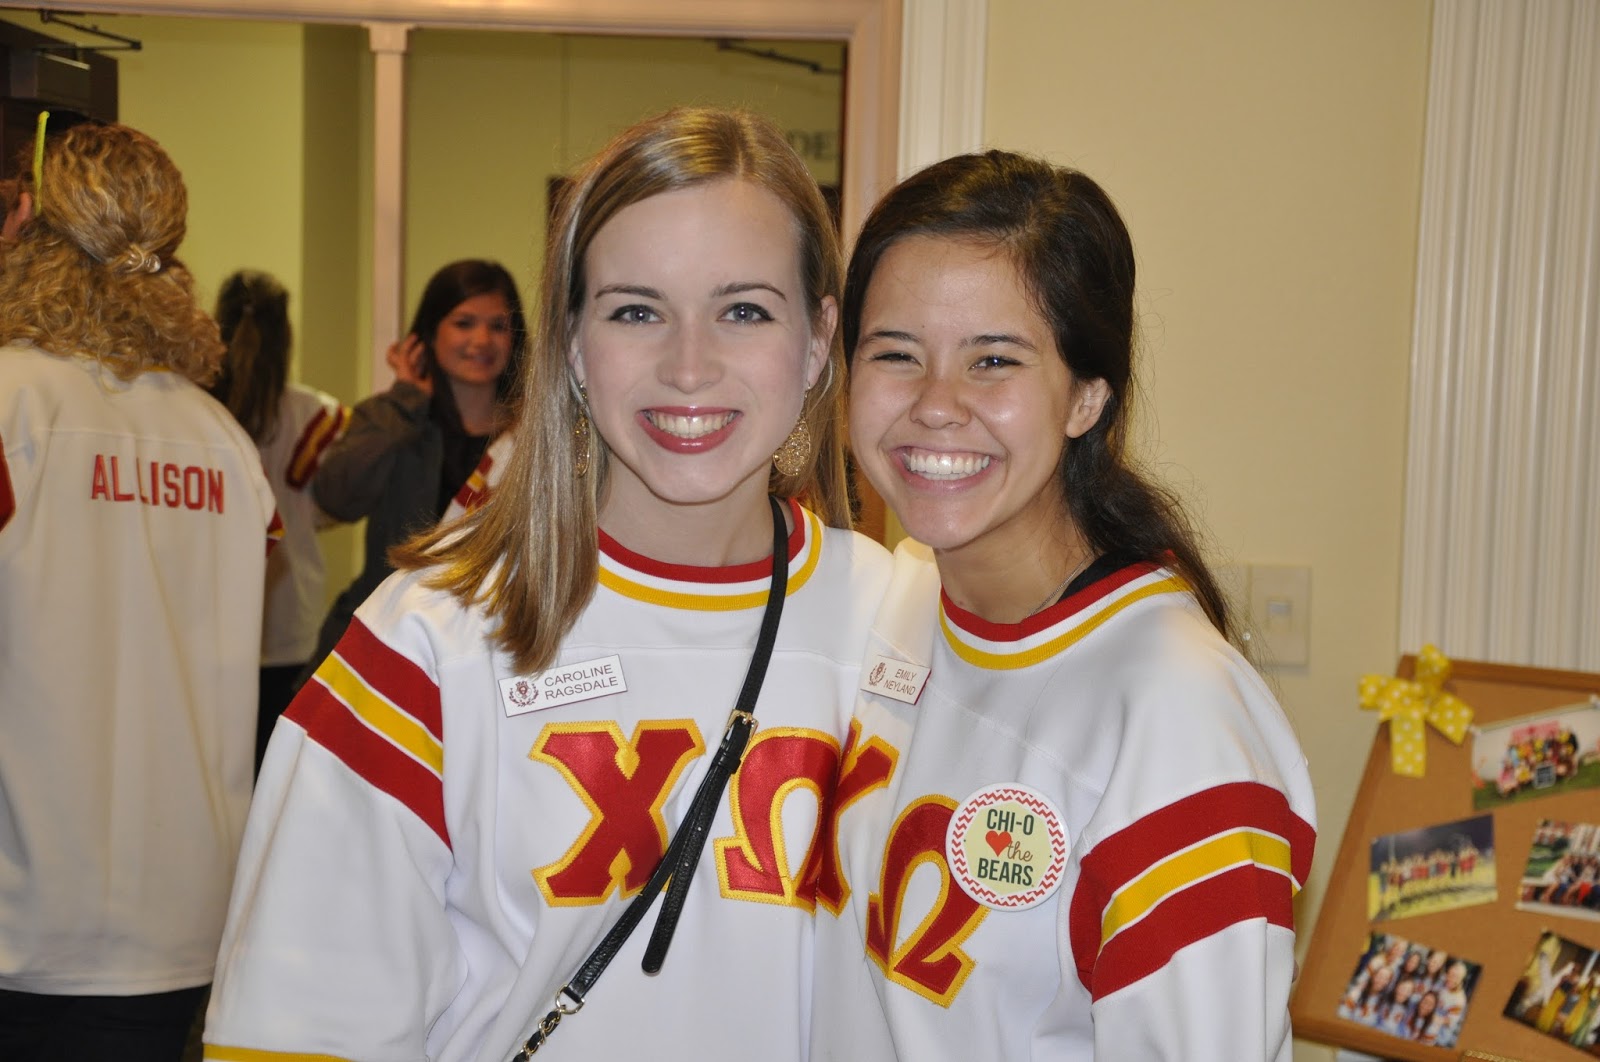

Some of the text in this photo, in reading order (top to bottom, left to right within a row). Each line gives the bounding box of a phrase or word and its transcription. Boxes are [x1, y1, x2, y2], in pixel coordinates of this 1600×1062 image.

[91, 454, 224, 514] ALISON
[544, 664, 613, 687] CAROLINE
[895, 668, 917, 682] EMILY
[544, 676, 618, 700] RAGSDALE
[883, 680, 916, 695] NEYLAND
[986, 808, 1035, 836] CHI-O
[1006, 840, 1033, 862] the
[977, 857, 1034, 886] BEARS
